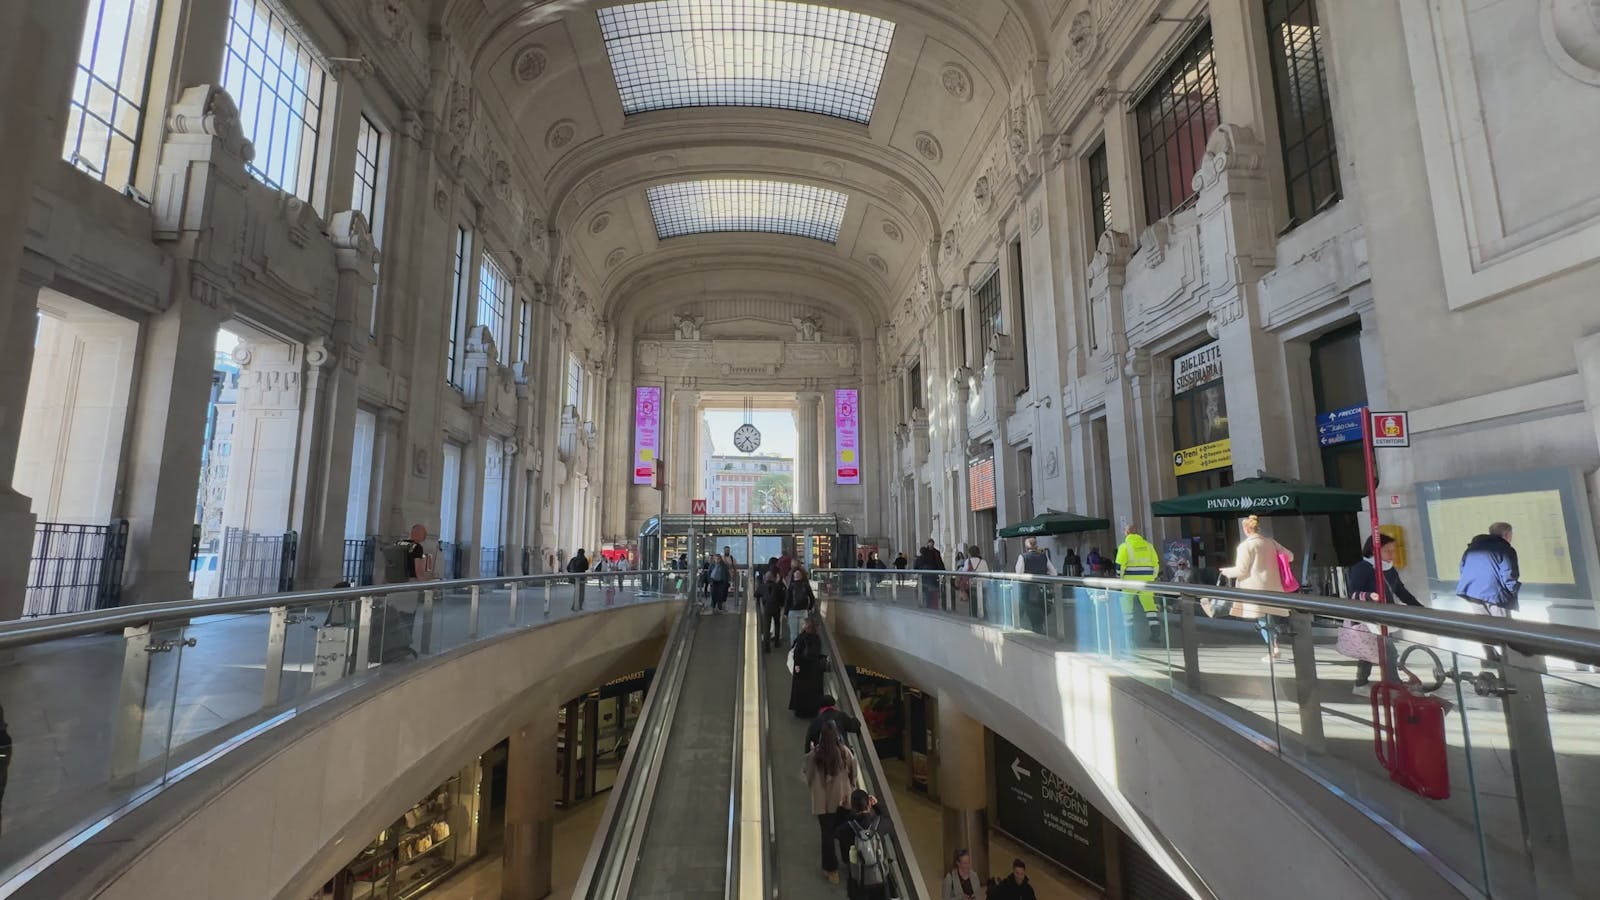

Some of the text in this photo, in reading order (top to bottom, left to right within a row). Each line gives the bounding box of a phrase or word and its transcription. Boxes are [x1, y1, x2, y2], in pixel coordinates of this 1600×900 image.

[1183, 448, 1198, 458] Treni
[693, 501, 706, 512] M
[1207, 498, 1239, 508] PANINO
[717, 527, 748, 535] VICTORIA
